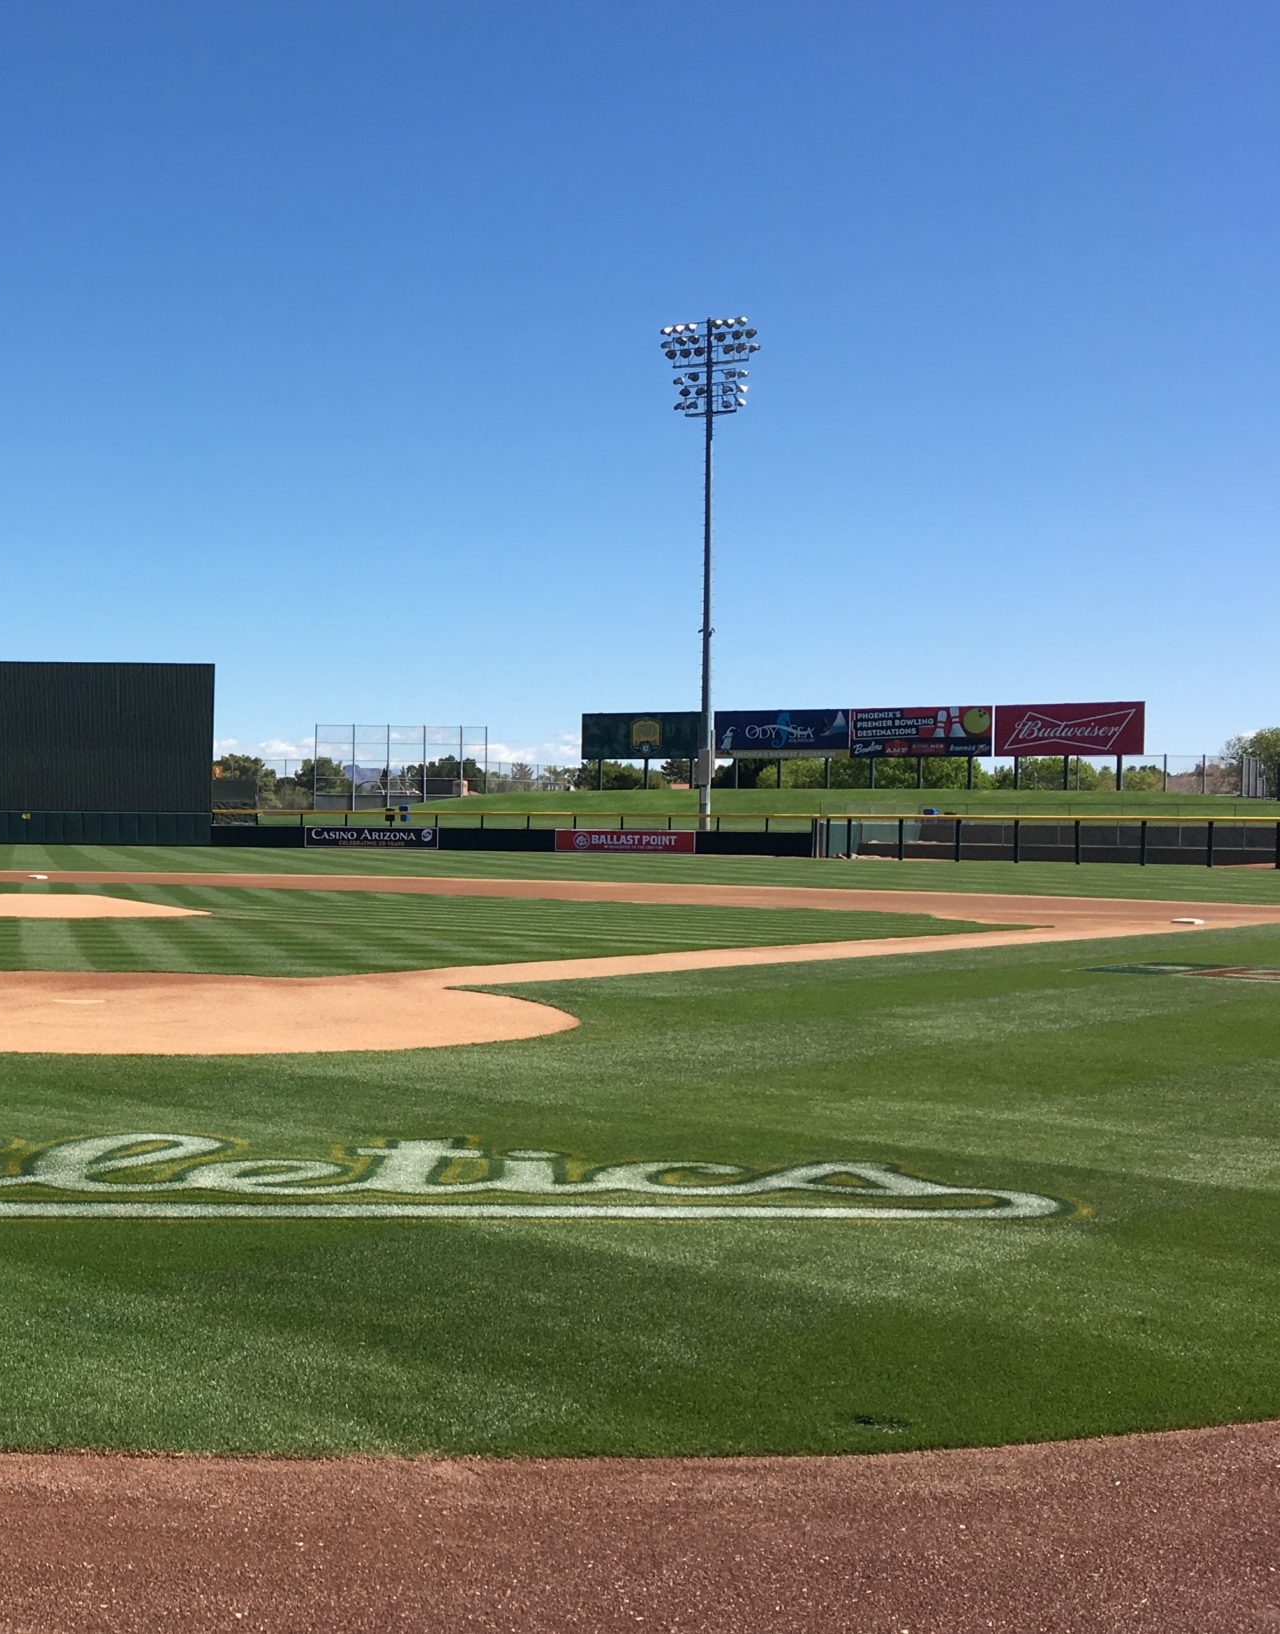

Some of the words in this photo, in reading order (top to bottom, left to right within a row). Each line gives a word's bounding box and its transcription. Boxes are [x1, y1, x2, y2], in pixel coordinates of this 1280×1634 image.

[857, 711, 901, 720] PHOENIX'S
[857, 720, 893, 728] PREMIER
[857, 728, 917, 737] DESTINATIONS
[1014, 720, 1120, 739] Budweiser
[311, 828, 357, 840] CASINO
[360, 829, 416, 840] ARIZONA
[591, 834, 640, 845] BALLAST
[642, 835, 677, 846] POINT
